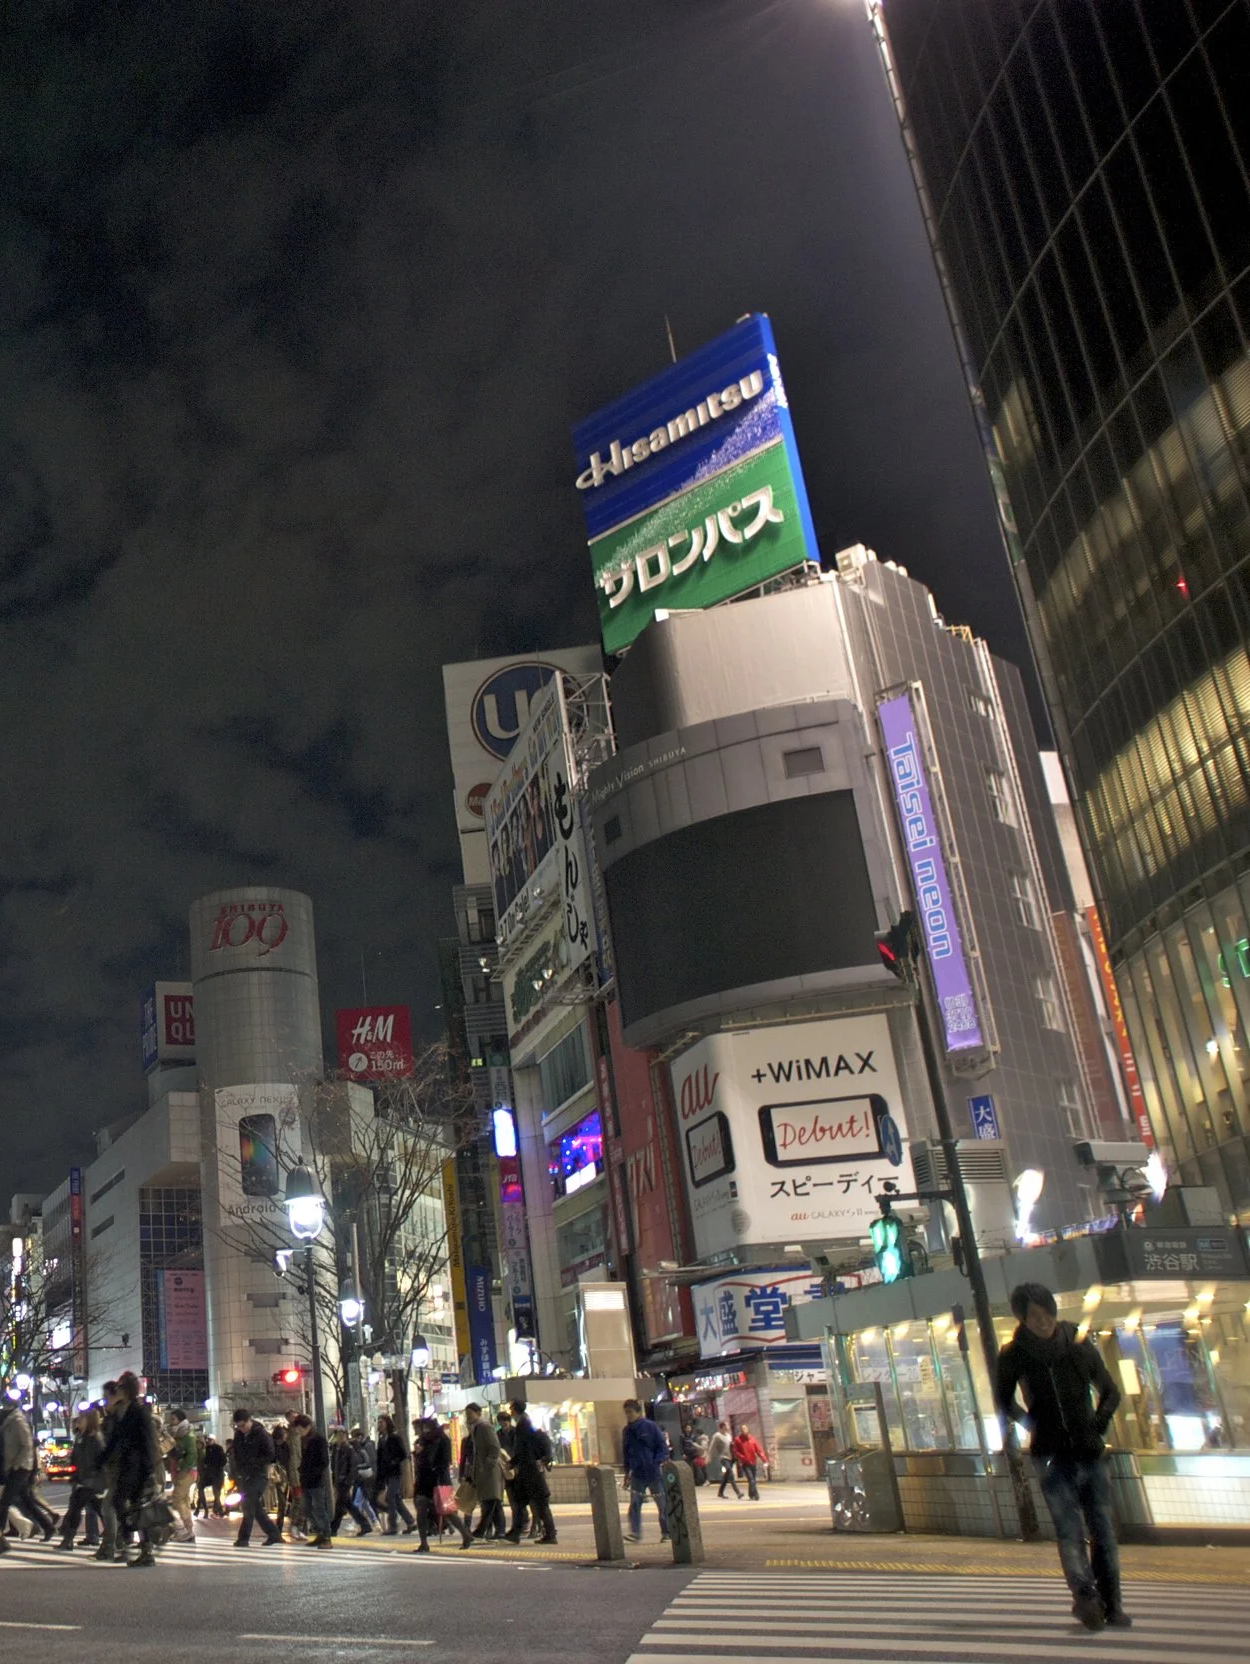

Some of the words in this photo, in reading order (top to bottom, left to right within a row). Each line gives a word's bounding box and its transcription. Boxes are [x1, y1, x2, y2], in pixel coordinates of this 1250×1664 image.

[576, 369, 764, 490] Hisamitsu
[600, 484, 784, 609] サロンパス
[616, 764, 645, 789] Vision
[649, 747, 687, 768] SHIBUYA
[890, 731, 935, 852] Taisei
[915, 858, 952, 960] neon
[221, 903, 284, 916] SHIBUYA
[210, 912, 288, 957] 109
[170, 1001, 194, 1018] UN
[170, 1022, 195, 1041] QL
[351, 1014, 395, 1045] H&M
[751, 1051, 877, 1084] +WiMAX
[681, 1064, 719, 1120] au
[777, 1111, 871, 1150] Debut!
[770, 1171, 899, 1198] スピーディー
[790, 1212, 809, 1221] au
[811, 1210, 845, 1220] GALAXY
[1144, 1253, 1200, 1271] 渋谷駅
[699, 1282, 846, 1342] 大盛堂
